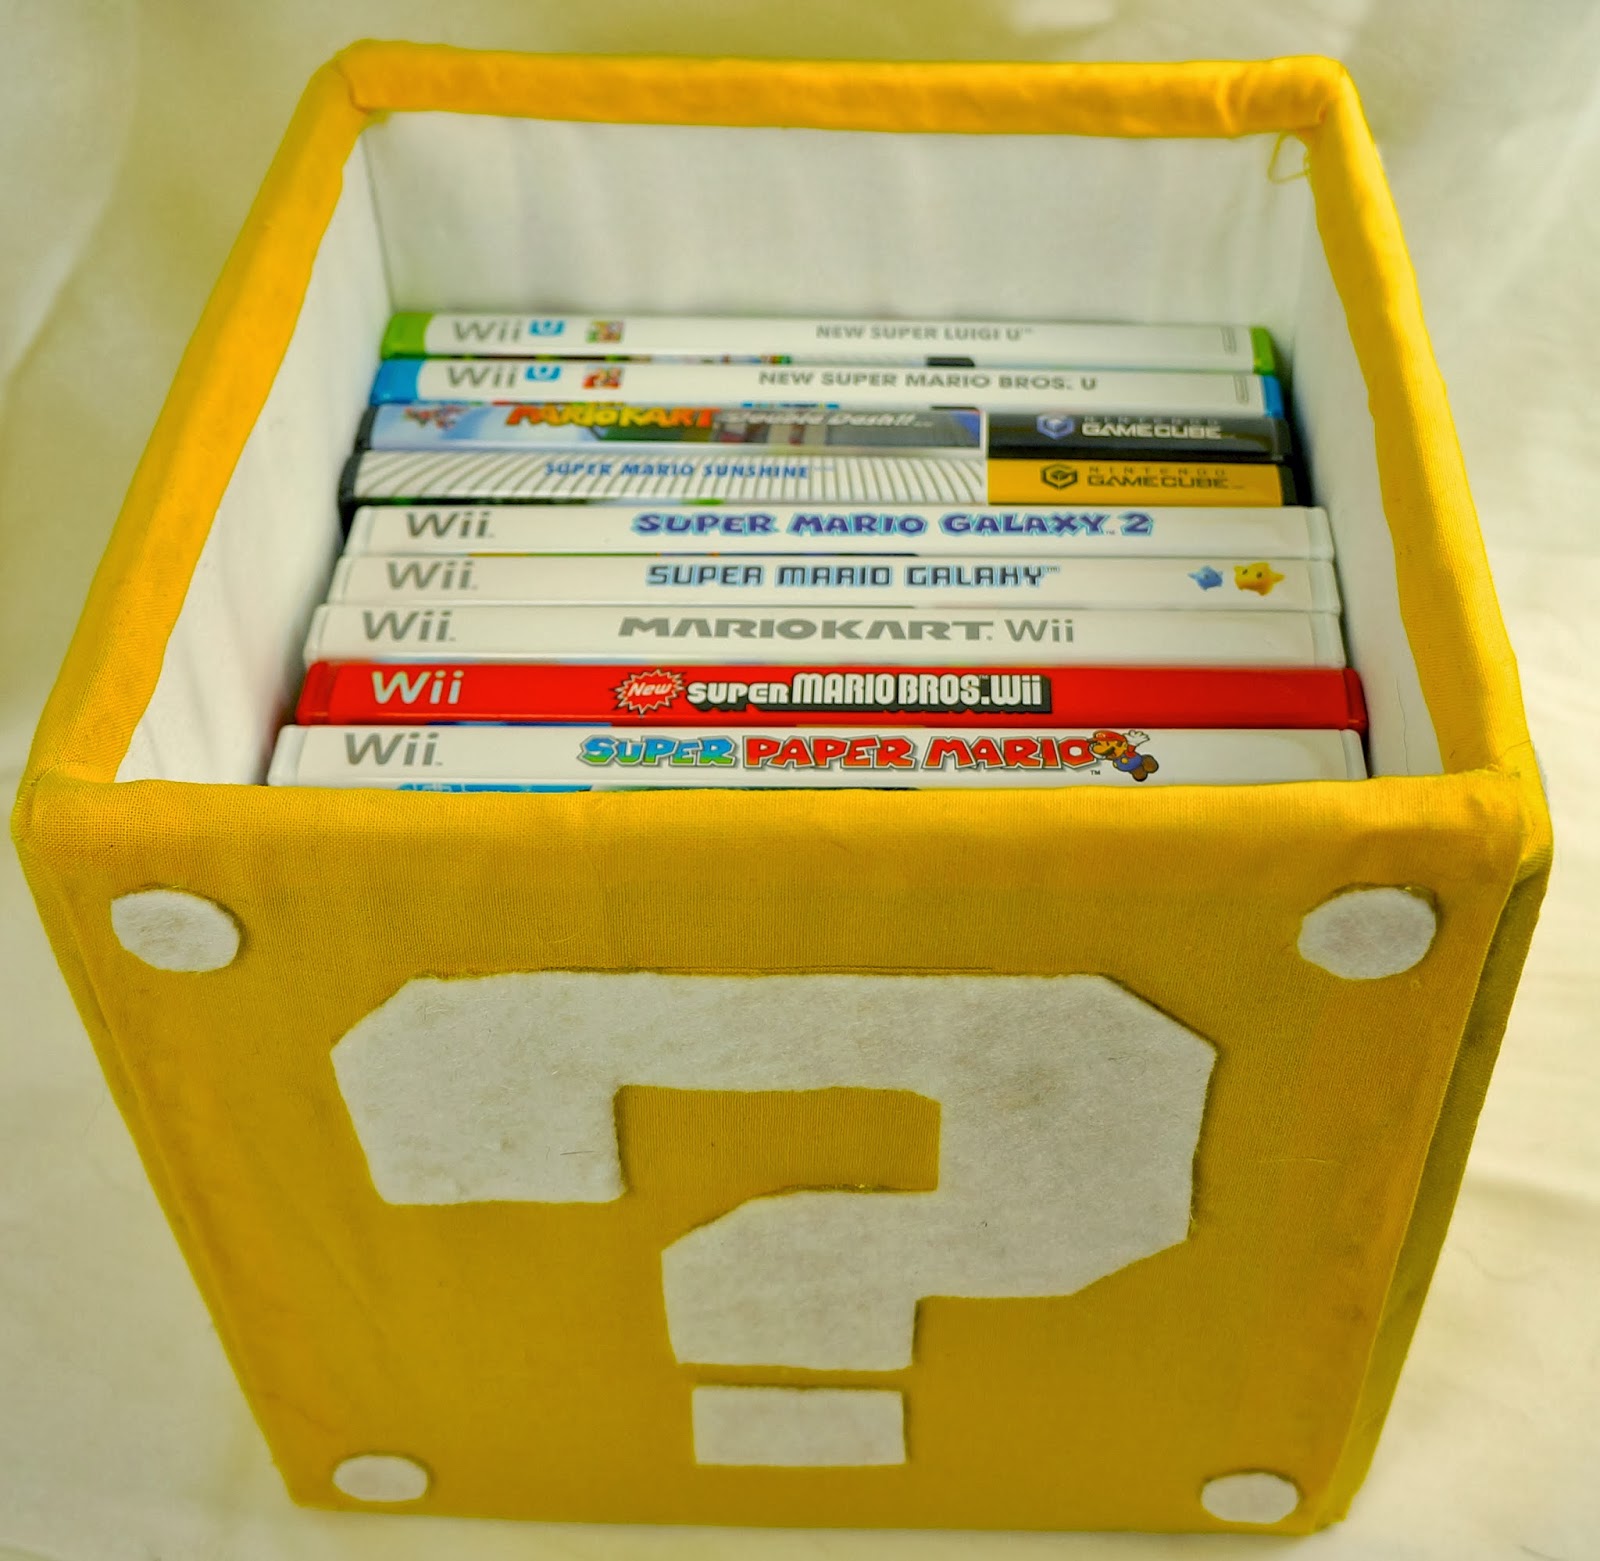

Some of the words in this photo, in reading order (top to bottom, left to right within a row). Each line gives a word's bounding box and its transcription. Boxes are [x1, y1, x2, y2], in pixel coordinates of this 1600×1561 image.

[453, 321, 522, 342] Wii
[816, 325, 865, 340] NEW
[870, 325, 937, 341] SUPER
[943, 326, 1000, 342] LUIGI
[448, 365, 517, 388] Wii
[758, 372, 815, 387] NEW
[821, 372, 897, 388] SUPER
[904, 373, 990, 389] MARIO
[998, 374, 1074, 391] BROS.
[1081, 376, 1098, 391] U
[1081, 422, 1222, 440] GAMECUBE
[543, 461, 612, 477] SUPER
[620, 463, 695, 478] MARIO
[702, 464, 809, 479] SUNSHINE
[1087, 474, 1229, 489] GAMECUBE
[1088, 466, 1227, 476] NINTENDO
[405, 511, 491, 540] Wii
[633, 513, 776, 535] SUPER
[791, 513, 925, 536] MARIO
[939, 513, 1103, 536] GALAXY
[1119, 513, 1153, 535] 2
[385, 560, 474, 591] Wii
[647, 565, 763, 586] SUPER
[776, 565, 890, 586] MARIO
[905, 566, 1045, 586] GALAXY
[361, 610, 453, 642] Wii
[1005, 619, 1074, 643] Wii
[370, 671, 464, 705] Wii
[628, 682, 673, 698] New
[687, 682, 790, 707] SUPER
[792, 673, 898, 705] MARIO
[343, 732, 440, 766] Wii
[578, 735, 736, 767] SUPER
[743, 736, 916, 768] PAPER
[922, 736, 1101, 769] MARIO
